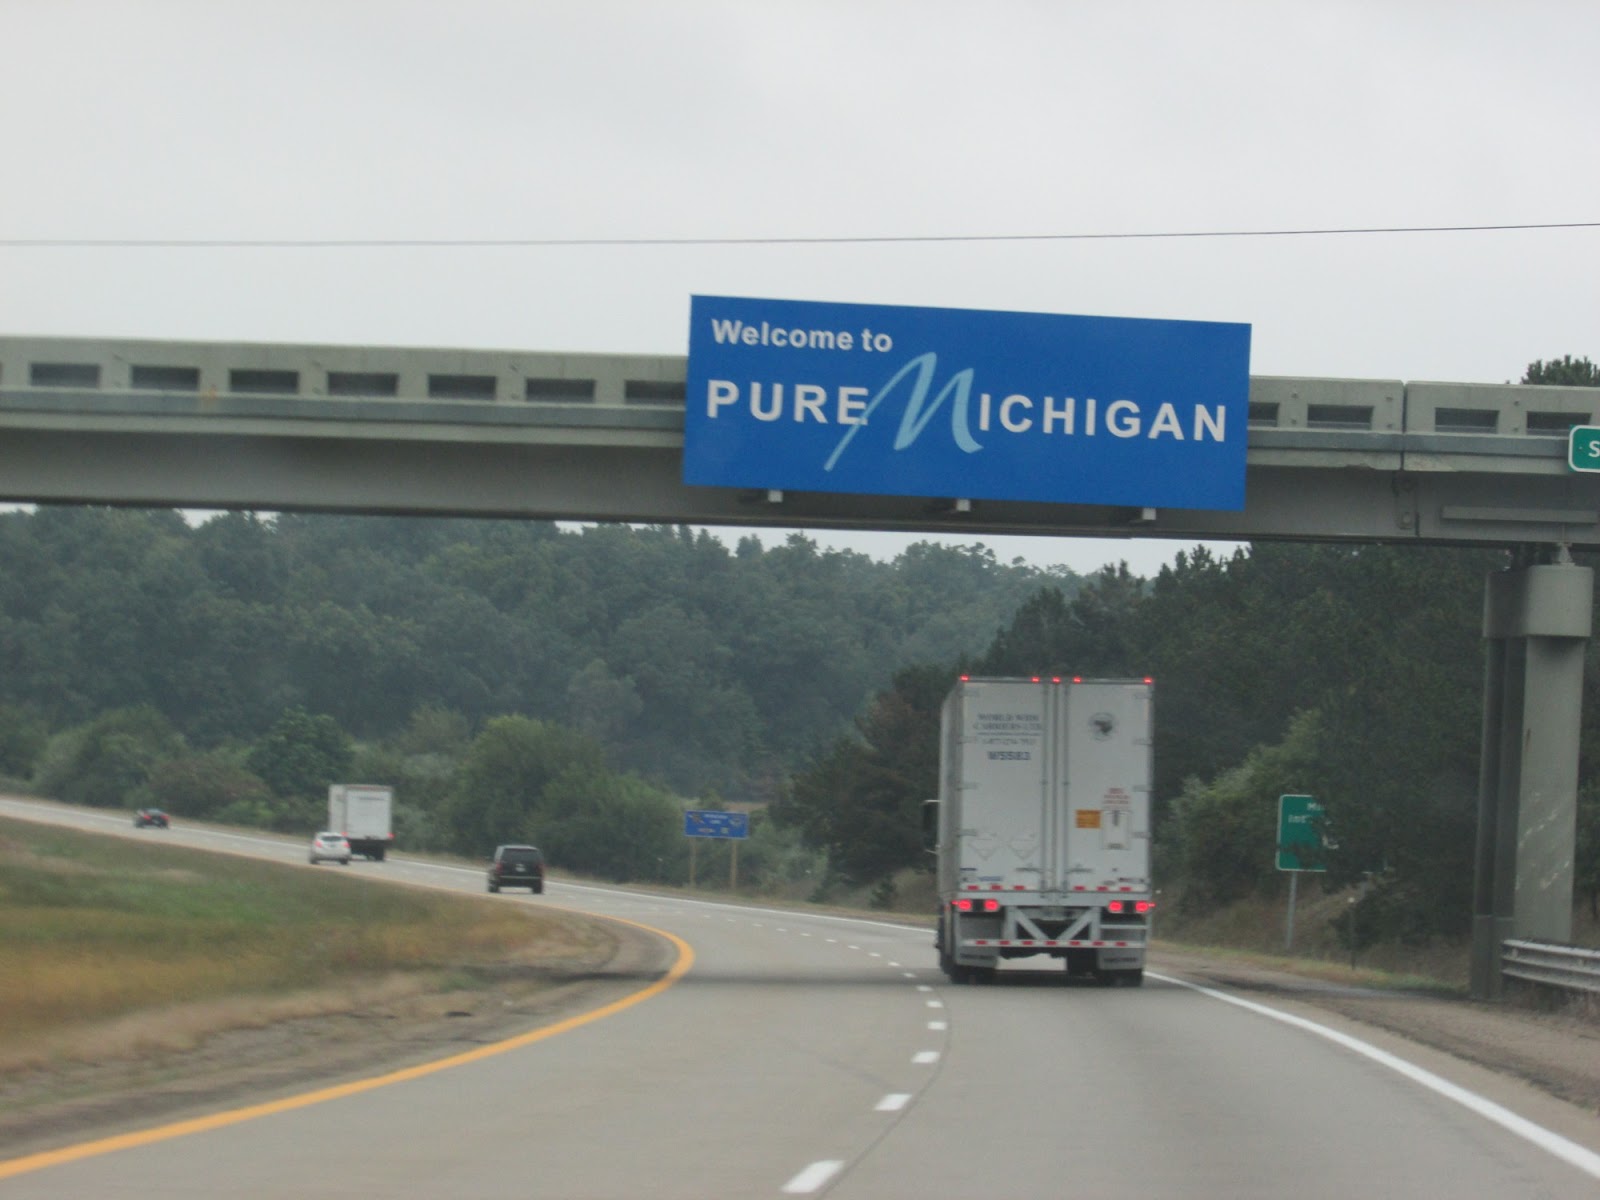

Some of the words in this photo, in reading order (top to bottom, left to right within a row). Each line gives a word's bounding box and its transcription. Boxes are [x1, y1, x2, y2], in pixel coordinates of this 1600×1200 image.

[711, 318, 854, 350] Welcome
[860, 328, 893, 352] to
[706, 379, 869, 426] PURE
[823, 351, 1226, 472] MICHIGAN
